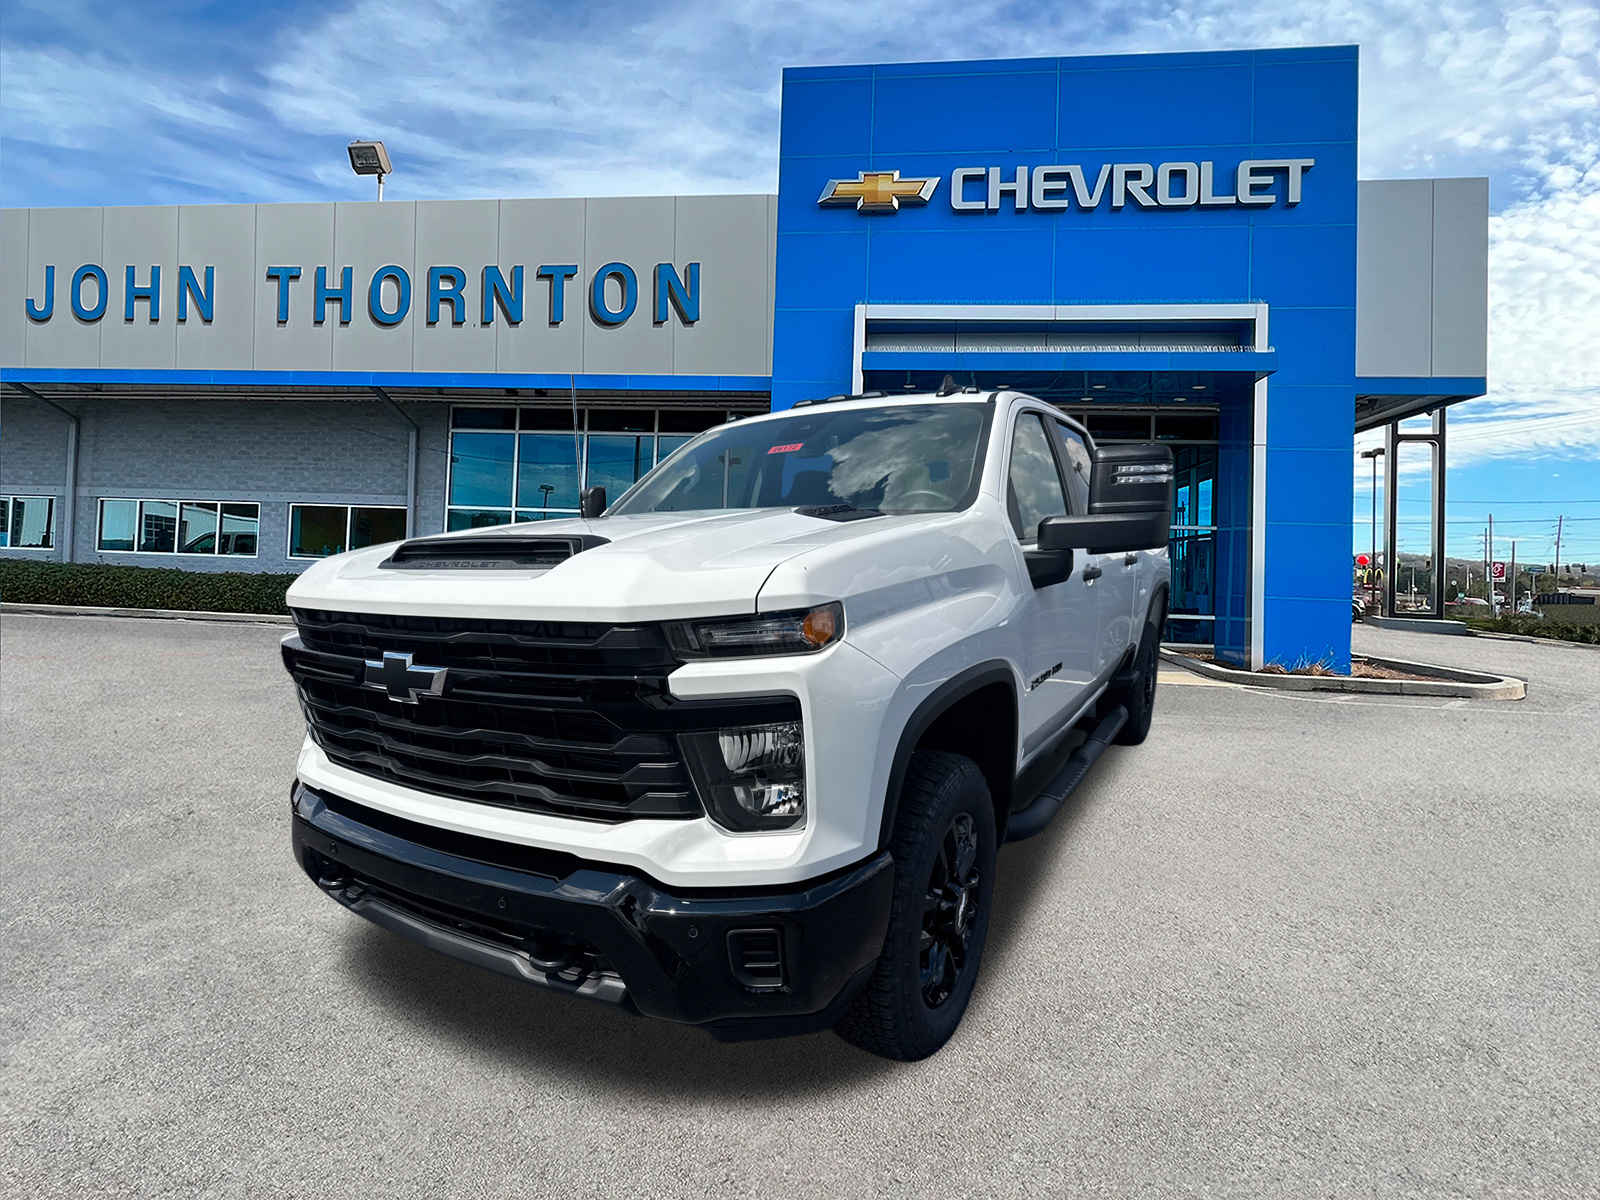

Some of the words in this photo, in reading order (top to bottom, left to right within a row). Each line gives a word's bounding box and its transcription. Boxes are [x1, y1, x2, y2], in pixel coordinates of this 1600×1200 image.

[951, 158, 1315, 213] CHEVROLET
[25, 263, 215, 324] JOHN
[266, 262, 701, 327] THORNTON
[417, 561, 500, 569] CHEVROLET
